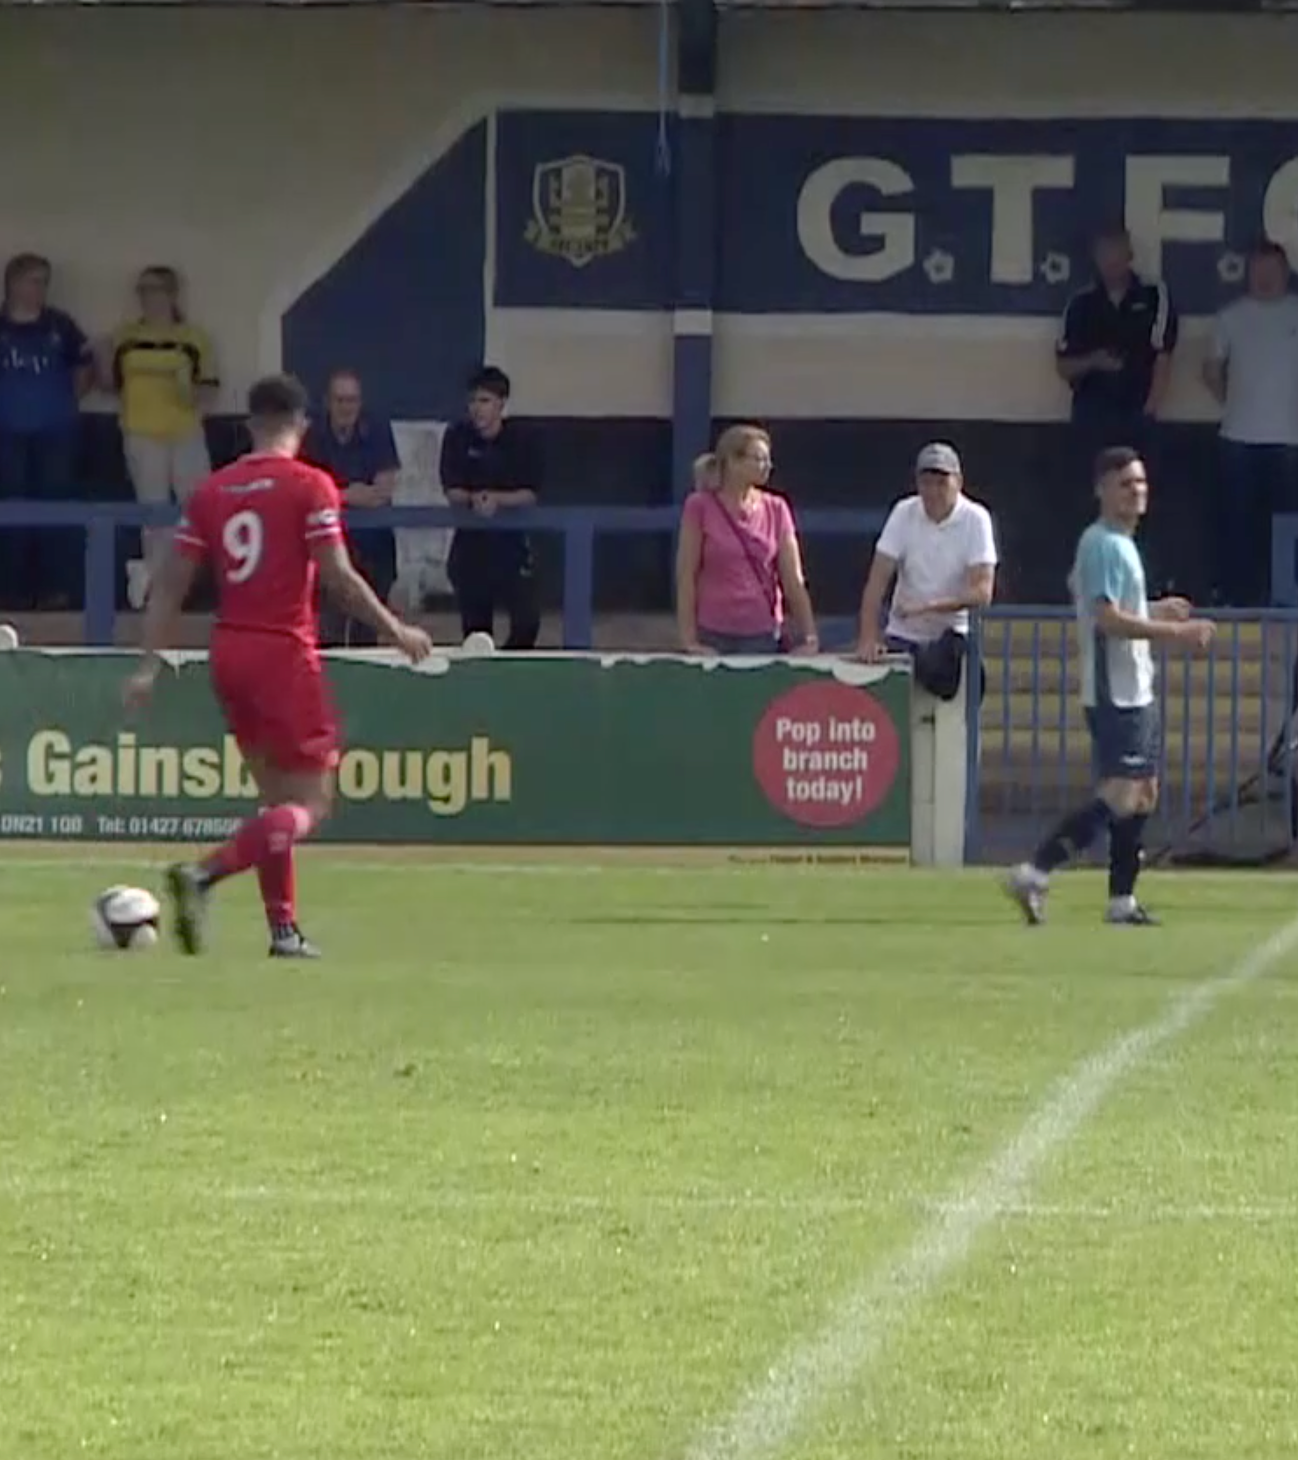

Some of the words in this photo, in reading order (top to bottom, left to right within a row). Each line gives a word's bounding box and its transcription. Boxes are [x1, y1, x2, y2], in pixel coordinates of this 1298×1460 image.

[222, 510, 264, 583] 9
[775, 717, 821, 746] Pop
[828, 715, 876, 742] into
[27, 729, 511, 815] Gainsbough
[782, 746, 868, 771] branch
[786, 776, 863, 806] today!
